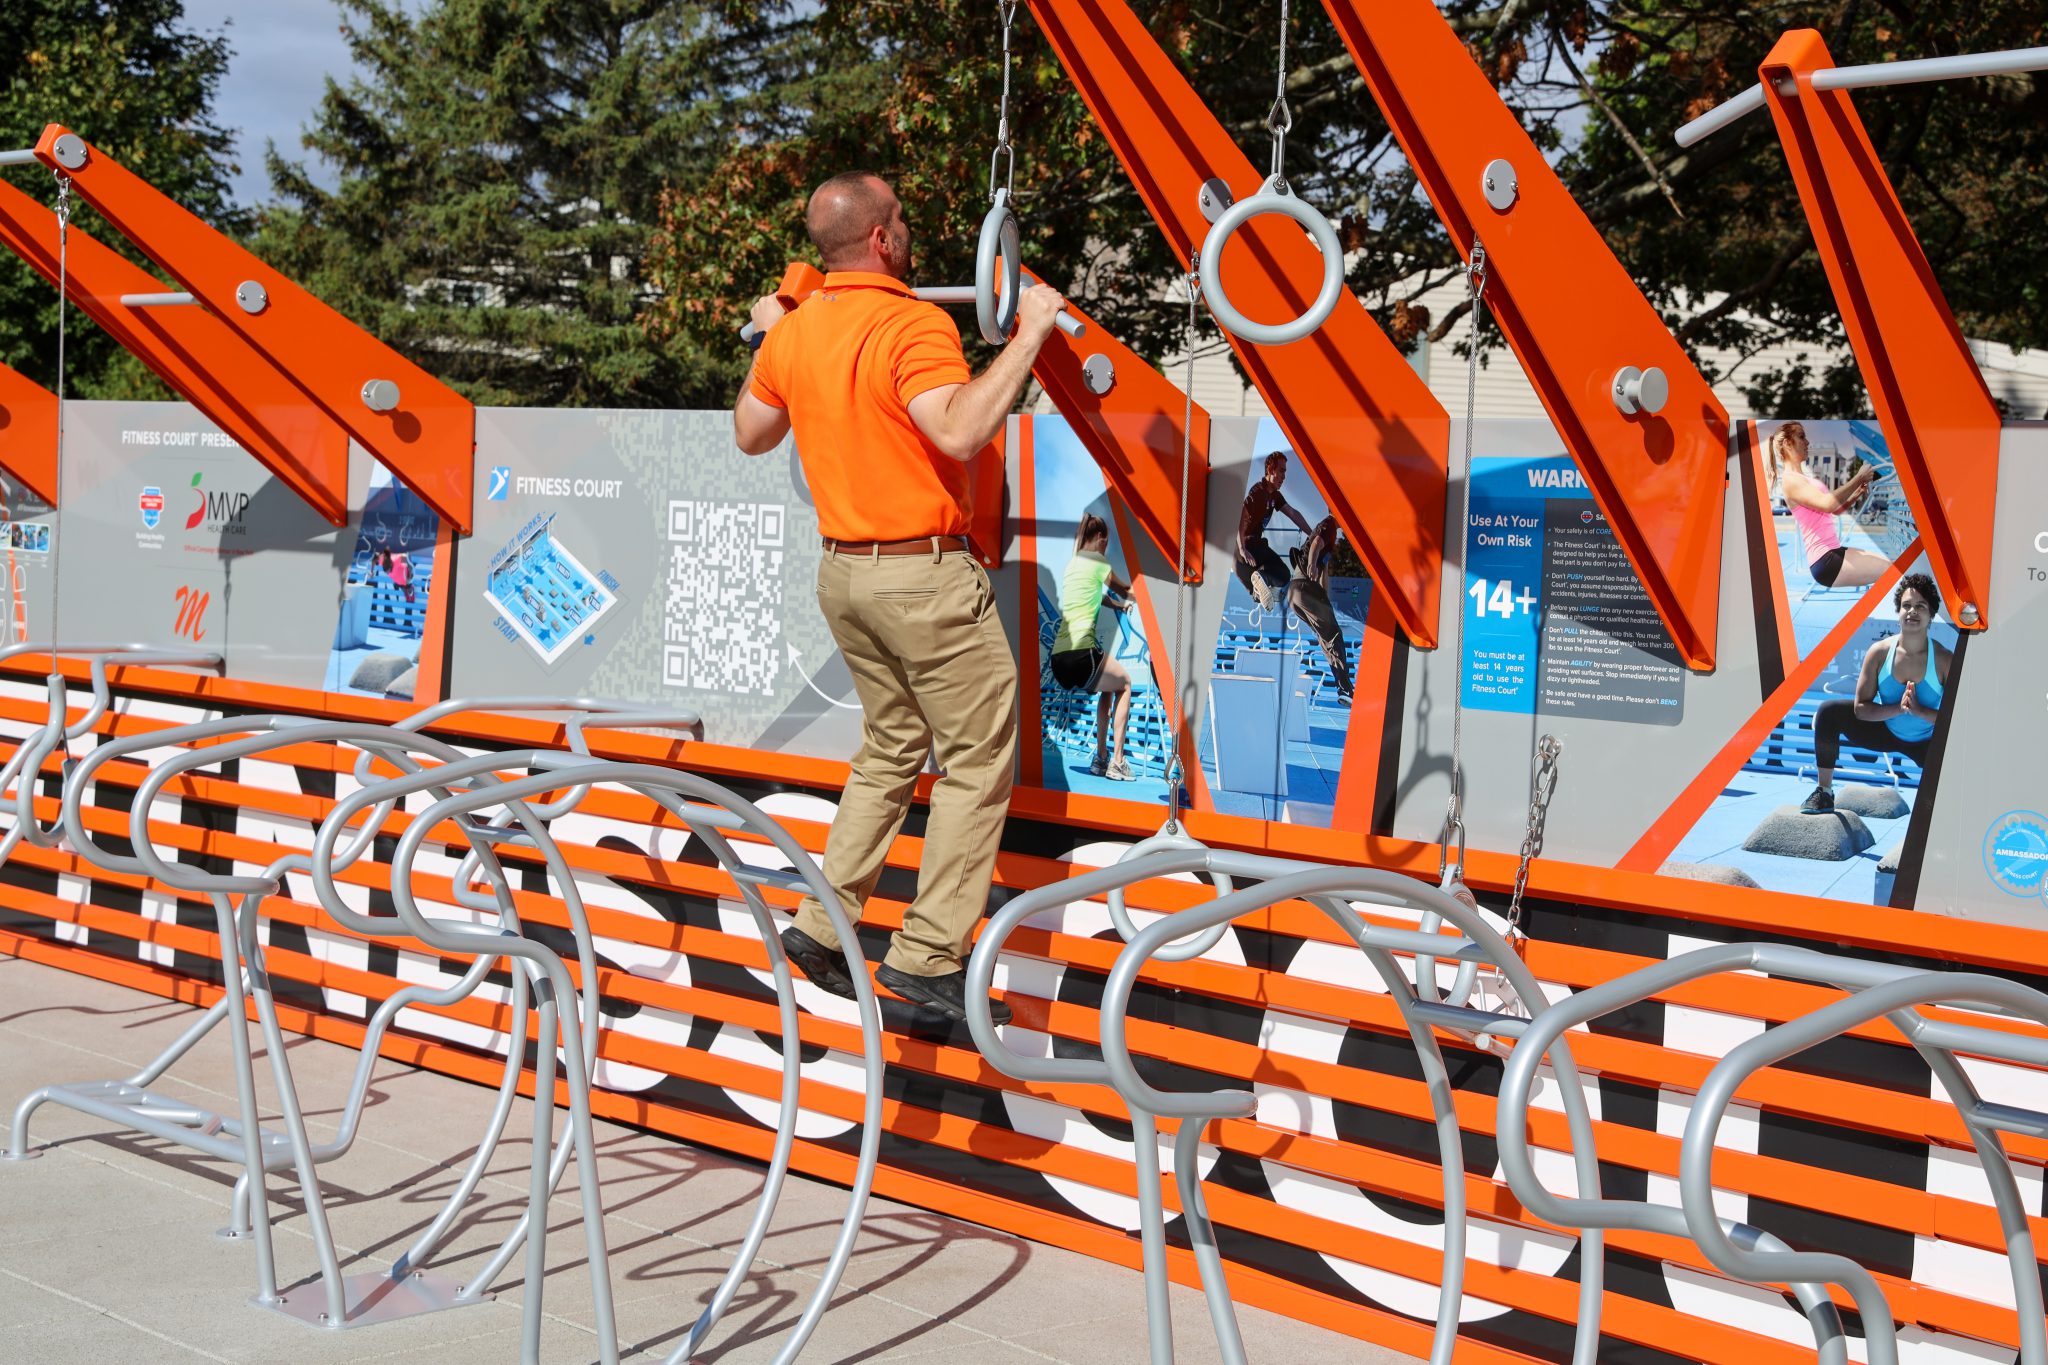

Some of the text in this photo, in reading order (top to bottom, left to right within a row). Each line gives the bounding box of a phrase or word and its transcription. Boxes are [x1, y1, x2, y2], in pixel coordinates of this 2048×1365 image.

[121, 430, 161, 446] FITNESS
[516, 476, 623, 499] FITNESS COURT
[207, 491, 250, 522] MVP
[1470, 514, 1539, 528] Use At Your
[491, 546, 508, 567] HOW
[516, 512, 542, 542] WORKS
[1477, 534, 1532, 547] Own Risk
[1468, 579, 1537, 619] 14+
[492, 615, 521, 643] START
[1564, 627, 1579, 635] PULL
[1589, 629, 1610, 637] children
[1583, 646, 1603, 654] Fitness
[1620, 640, 1637, 648] weigh
[1474, 650, 1525, 662] You must be at
[1472, 662, 1524, 673] least 14 years
[1547, 658, 1570, 666] Maintain
[1570, 659, 1593, 667] AGILITY
[1601, 662, 1623, 671] wearing
[1642, 664, 1667, 672] footwear
[1472, 673, 1524, 684] old to use the
[1546, 675, 1561, 683] dizzy
[1547, 667, 1570, 675] avoiding
[1605, 670, 1619, 678] Stop
[1620, 672, 1652, 681] immediately
[1472, 684, 1496, 694] Fitness
[1626, 695, 1645, 703] Please
[1660, 698, 1678, 706] BEND
